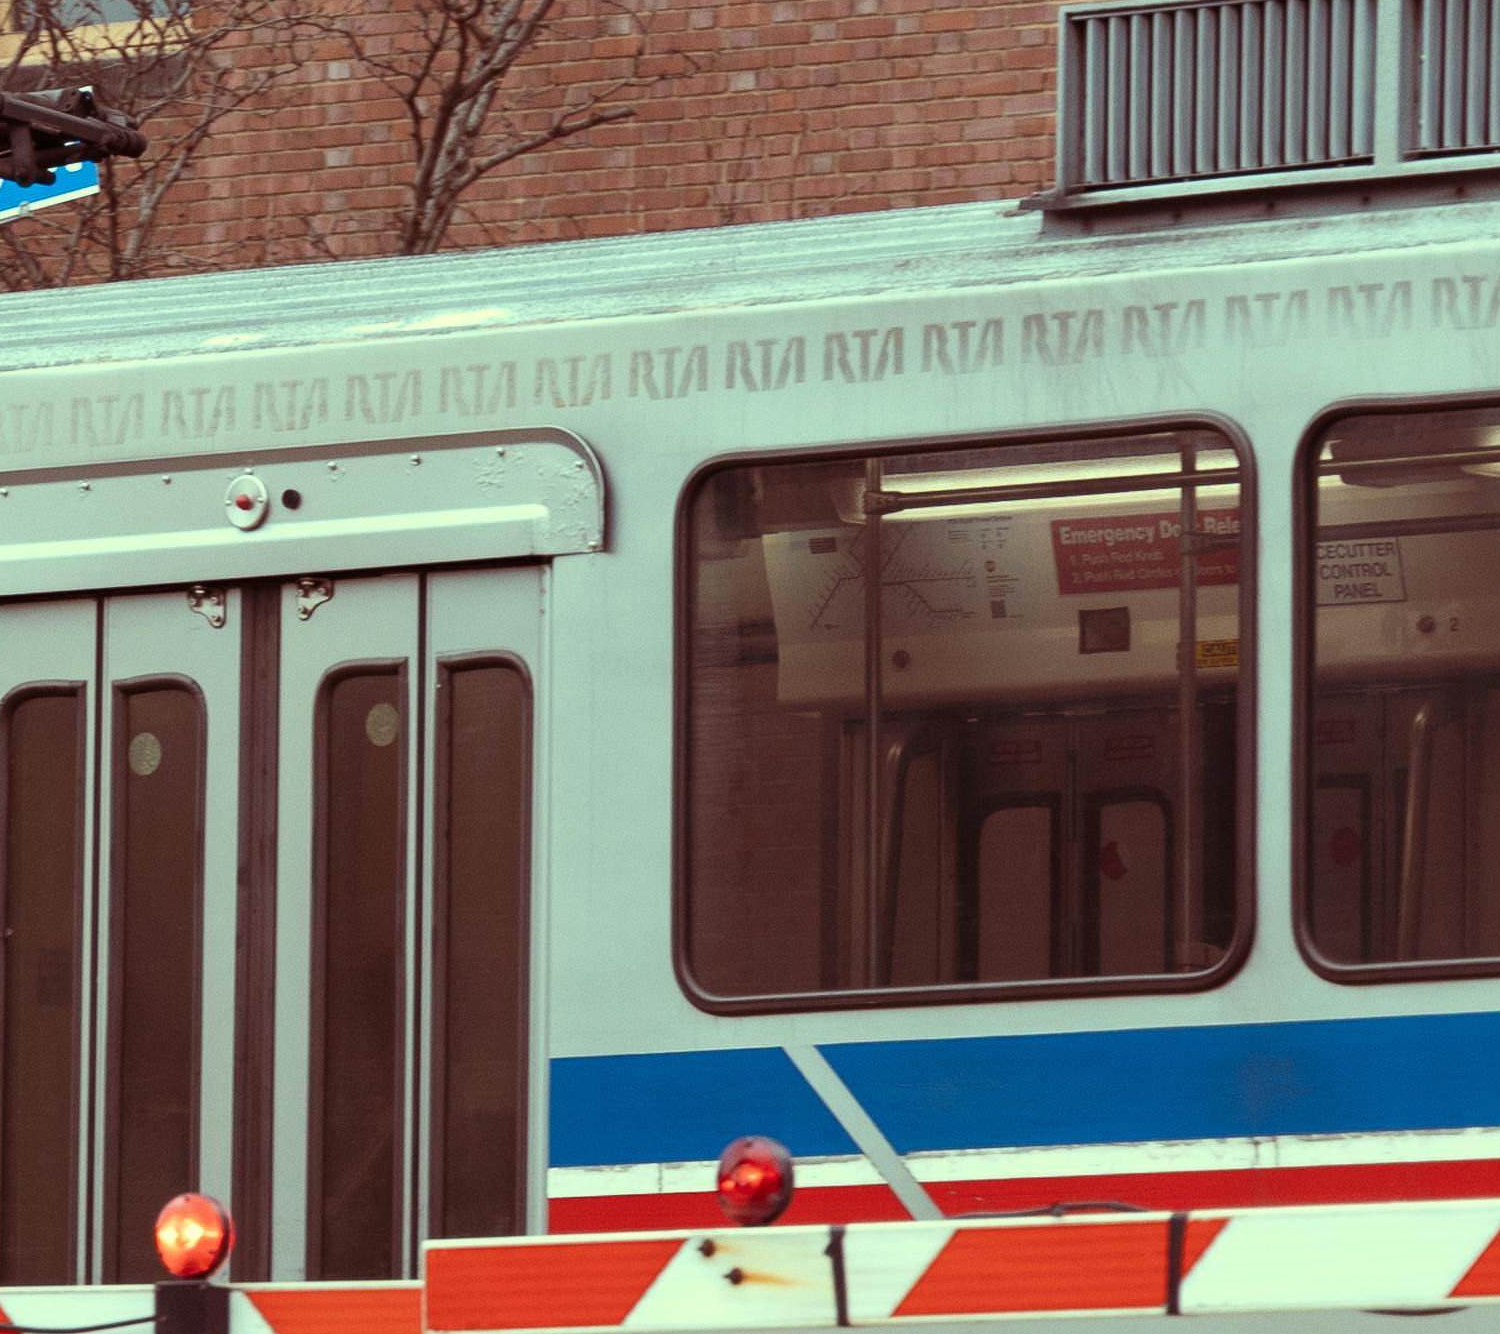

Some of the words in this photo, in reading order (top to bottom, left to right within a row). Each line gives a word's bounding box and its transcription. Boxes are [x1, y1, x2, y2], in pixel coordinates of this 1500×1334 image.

[160, 385, 236, 438] RTA
[252, 378, 328, 431] RTA
[344, 368, 422, 424] RTA
[438, 361, 517, 415] RTA
[534, 353, 612, 408] RTA
[628, 344, 709, 400] RTA
[725, 336, 807, 392] RTA
[822, 326, 905, 383] RTA
[921, 316, 1004, 375] RTA
[1020, 309, 1105, 365] RTA
[1120, 299, 1206, 357] RTA
[1326, 281, 1413, 340] RTA
[1059, 525, 1154, 547] Emergency
[1320, 562, 1393, 579] CONTROL
[1334, 583, 1383, 598] PANEL
[1449, 617, 1460, 632] 2
